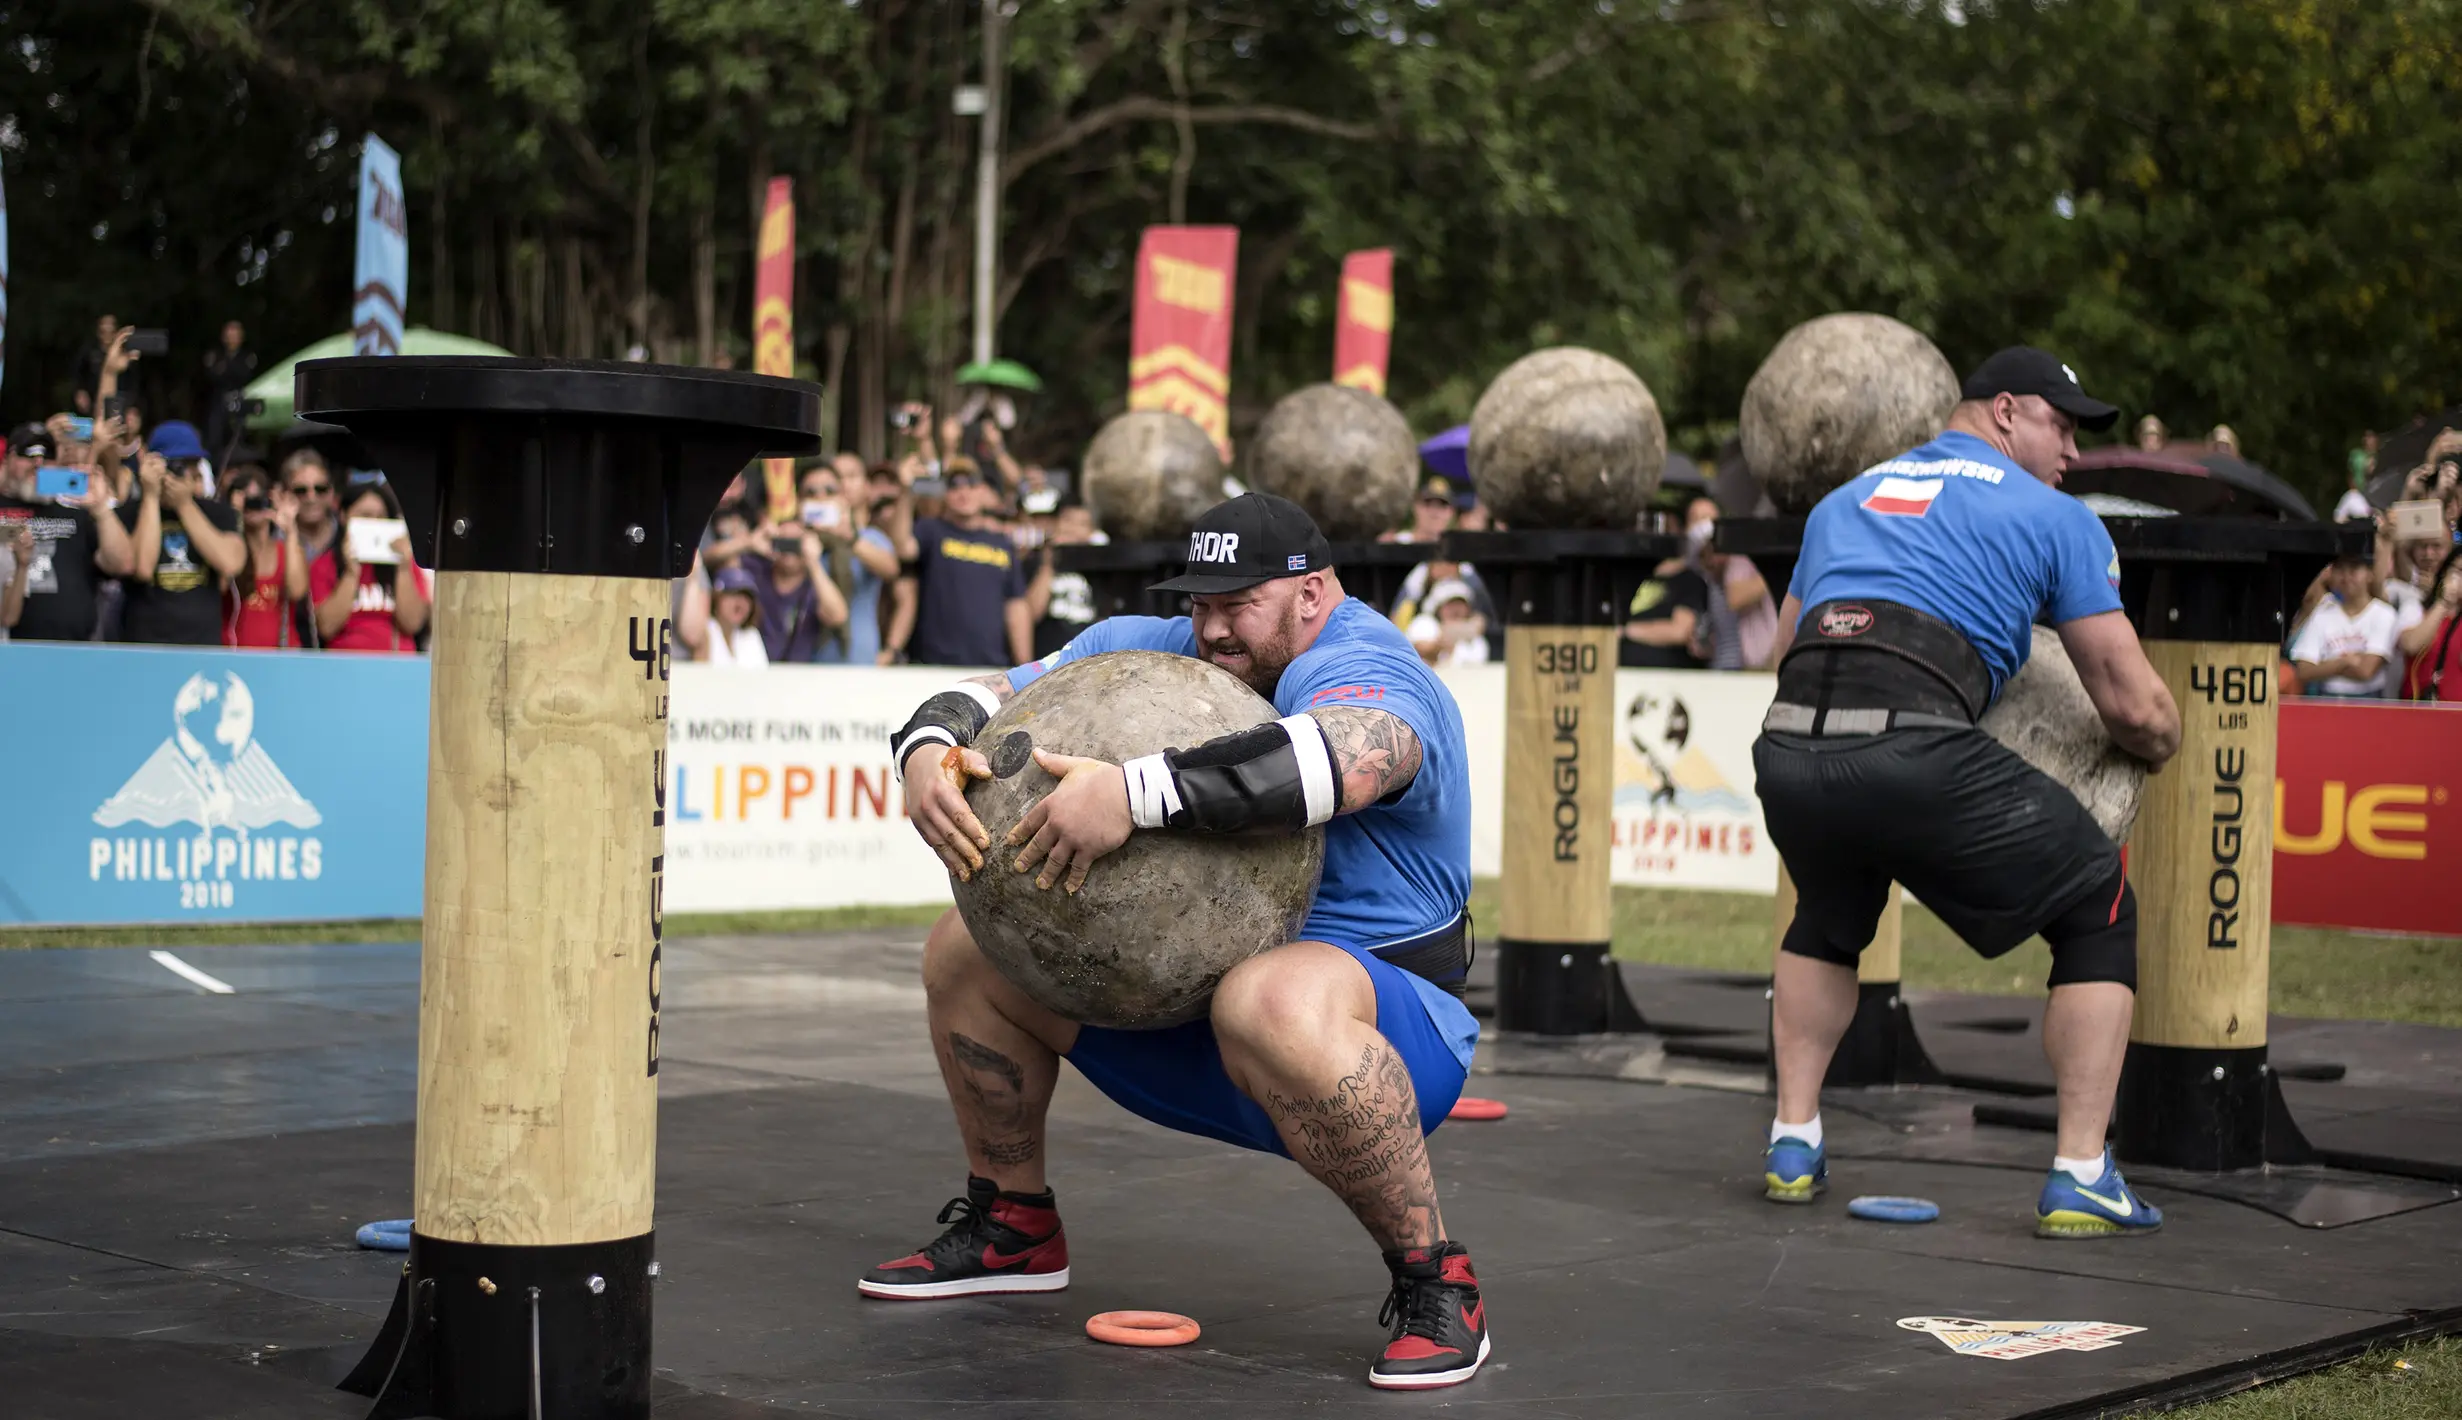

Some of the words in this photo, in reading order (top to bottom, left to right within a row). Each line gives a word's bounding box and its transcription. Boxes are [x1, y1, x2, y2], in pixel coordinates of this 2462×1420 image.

[1188, 532, 1240, 564] THOR
[1537, 643, 1598, 674] 390
[2190, 664, 2267, 705] 460
[688, 720, 755, 742] MORE
[766, 721, 810, 742] FUN
[820, 722, 843, 741] IN
[851, 722, 890, 741] THE
[2218, 712, 2248, 730] LBS
[676, 764, 910, 821] LIPPIN
[1554, 705, 1579, 863] ROGUE
[89, 837, 322, 881] PHILIPPINES
[2207, 747, 2245, 948] ROGUE
